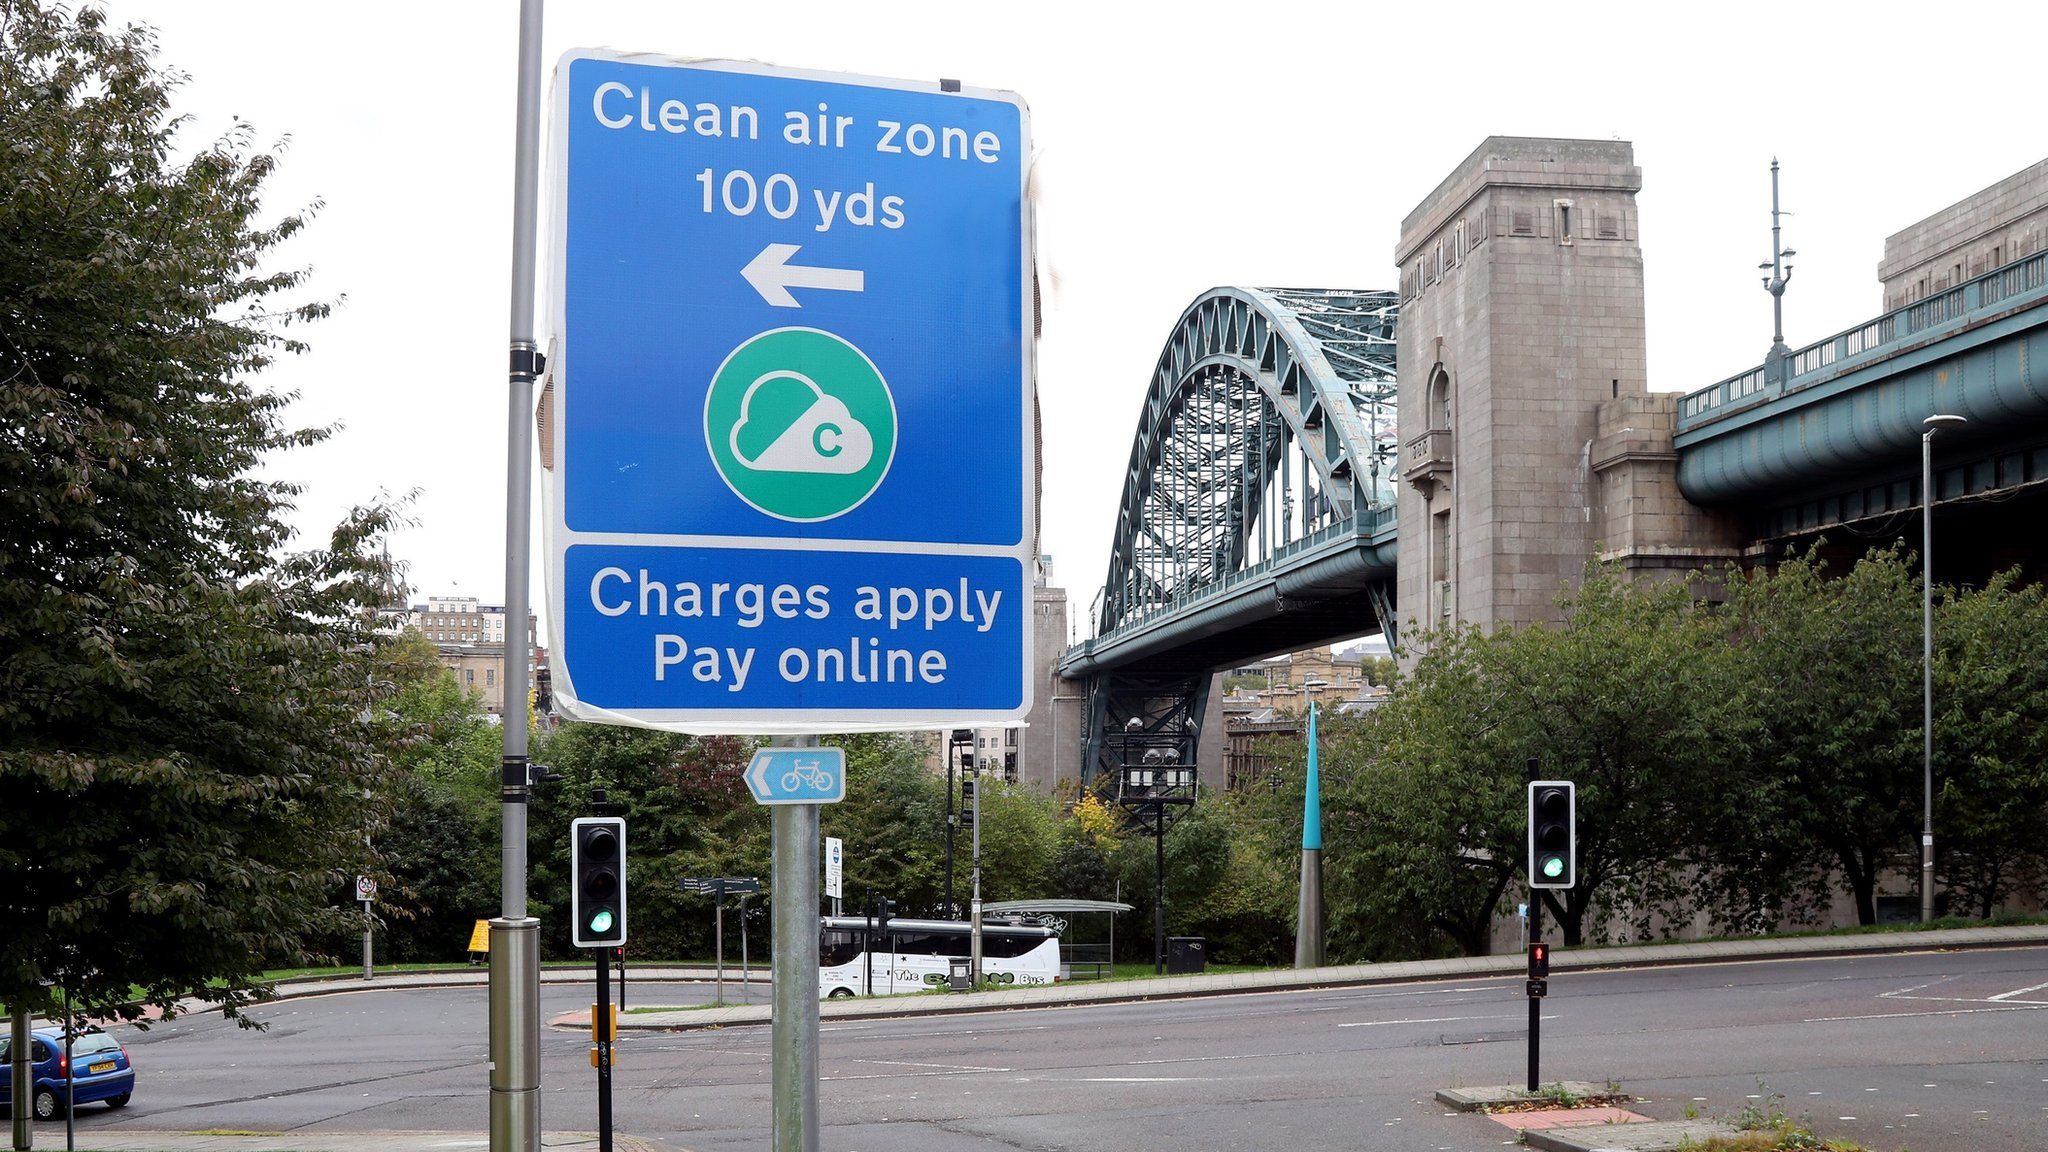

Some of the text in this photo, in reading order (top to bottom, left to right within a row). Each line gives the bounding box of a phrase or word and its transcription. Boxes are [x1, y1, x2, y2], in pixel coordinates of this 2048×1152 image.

[592, 80, 1002, 165] Clean air zone
[696, 167, 906, 233] 100 yds
[812, 422, 844, 458] C
[589, 566, 1003, 633] Charges apply
[654, 633, 948, 693] Pay online
[894, 969, 919, 981] The
[923, 972, 1014, 985] BM
[1020, 974, 1045, 985] Bus
